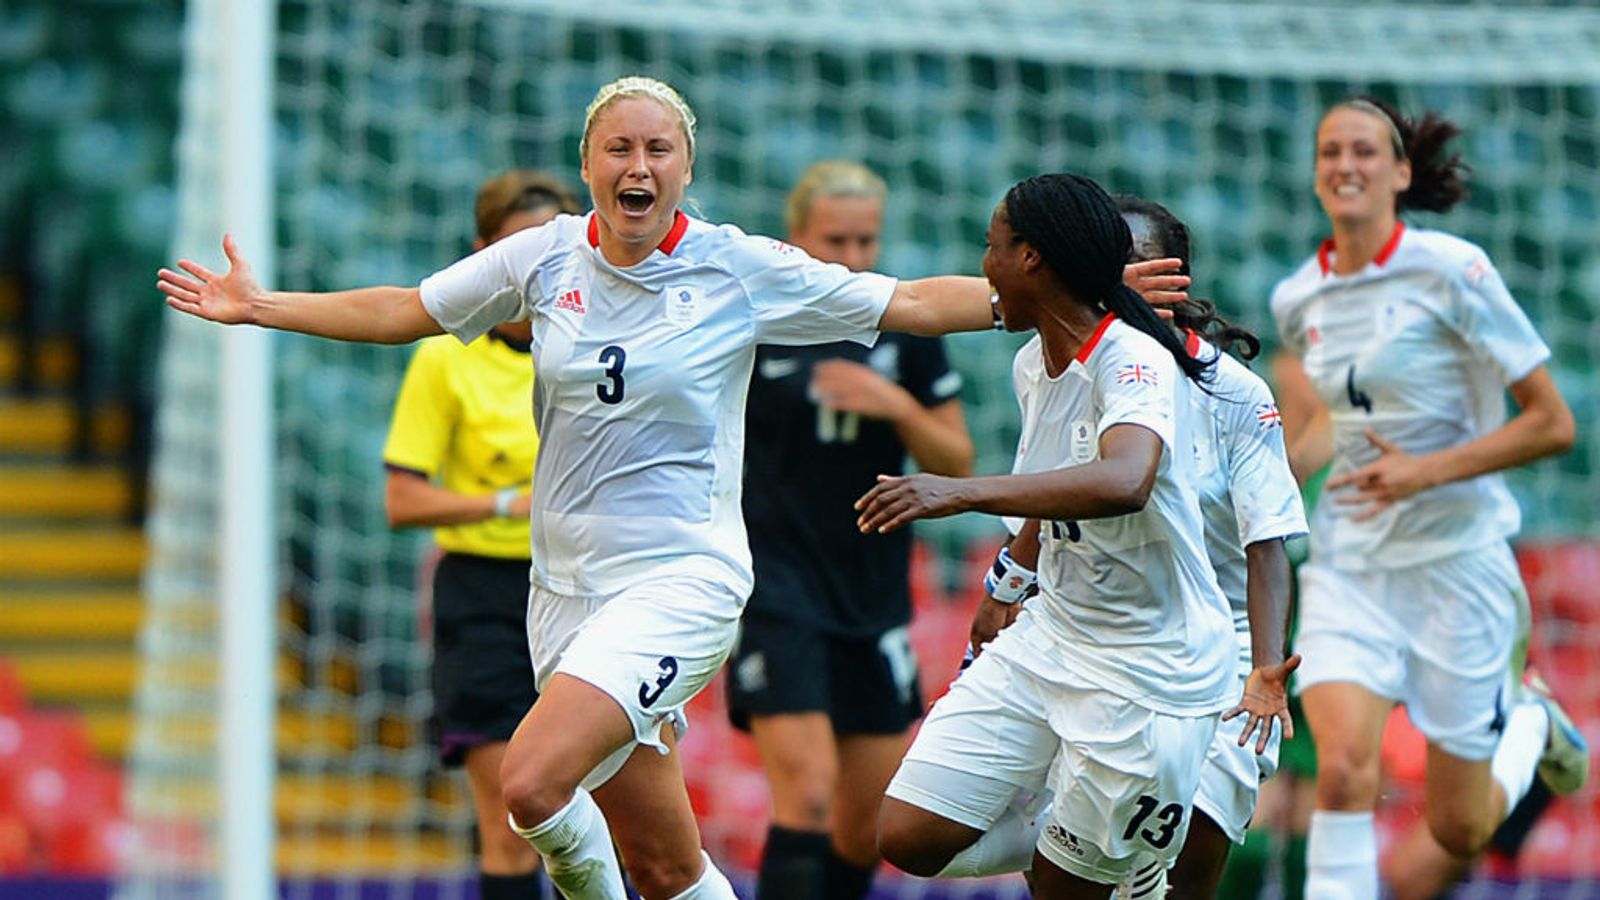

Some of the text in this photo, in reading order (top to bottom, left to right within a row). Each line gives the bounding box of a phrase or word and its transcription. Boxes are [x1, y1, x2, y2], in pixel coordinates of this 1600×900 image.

[597, 346, 626, 404] 3
[1347, 364, 1373, 415] 4
[639, 656, 678, 708] 3
[1046, 825, 1084, 856] adidas
[1123, 795, 1183, 849] 13
